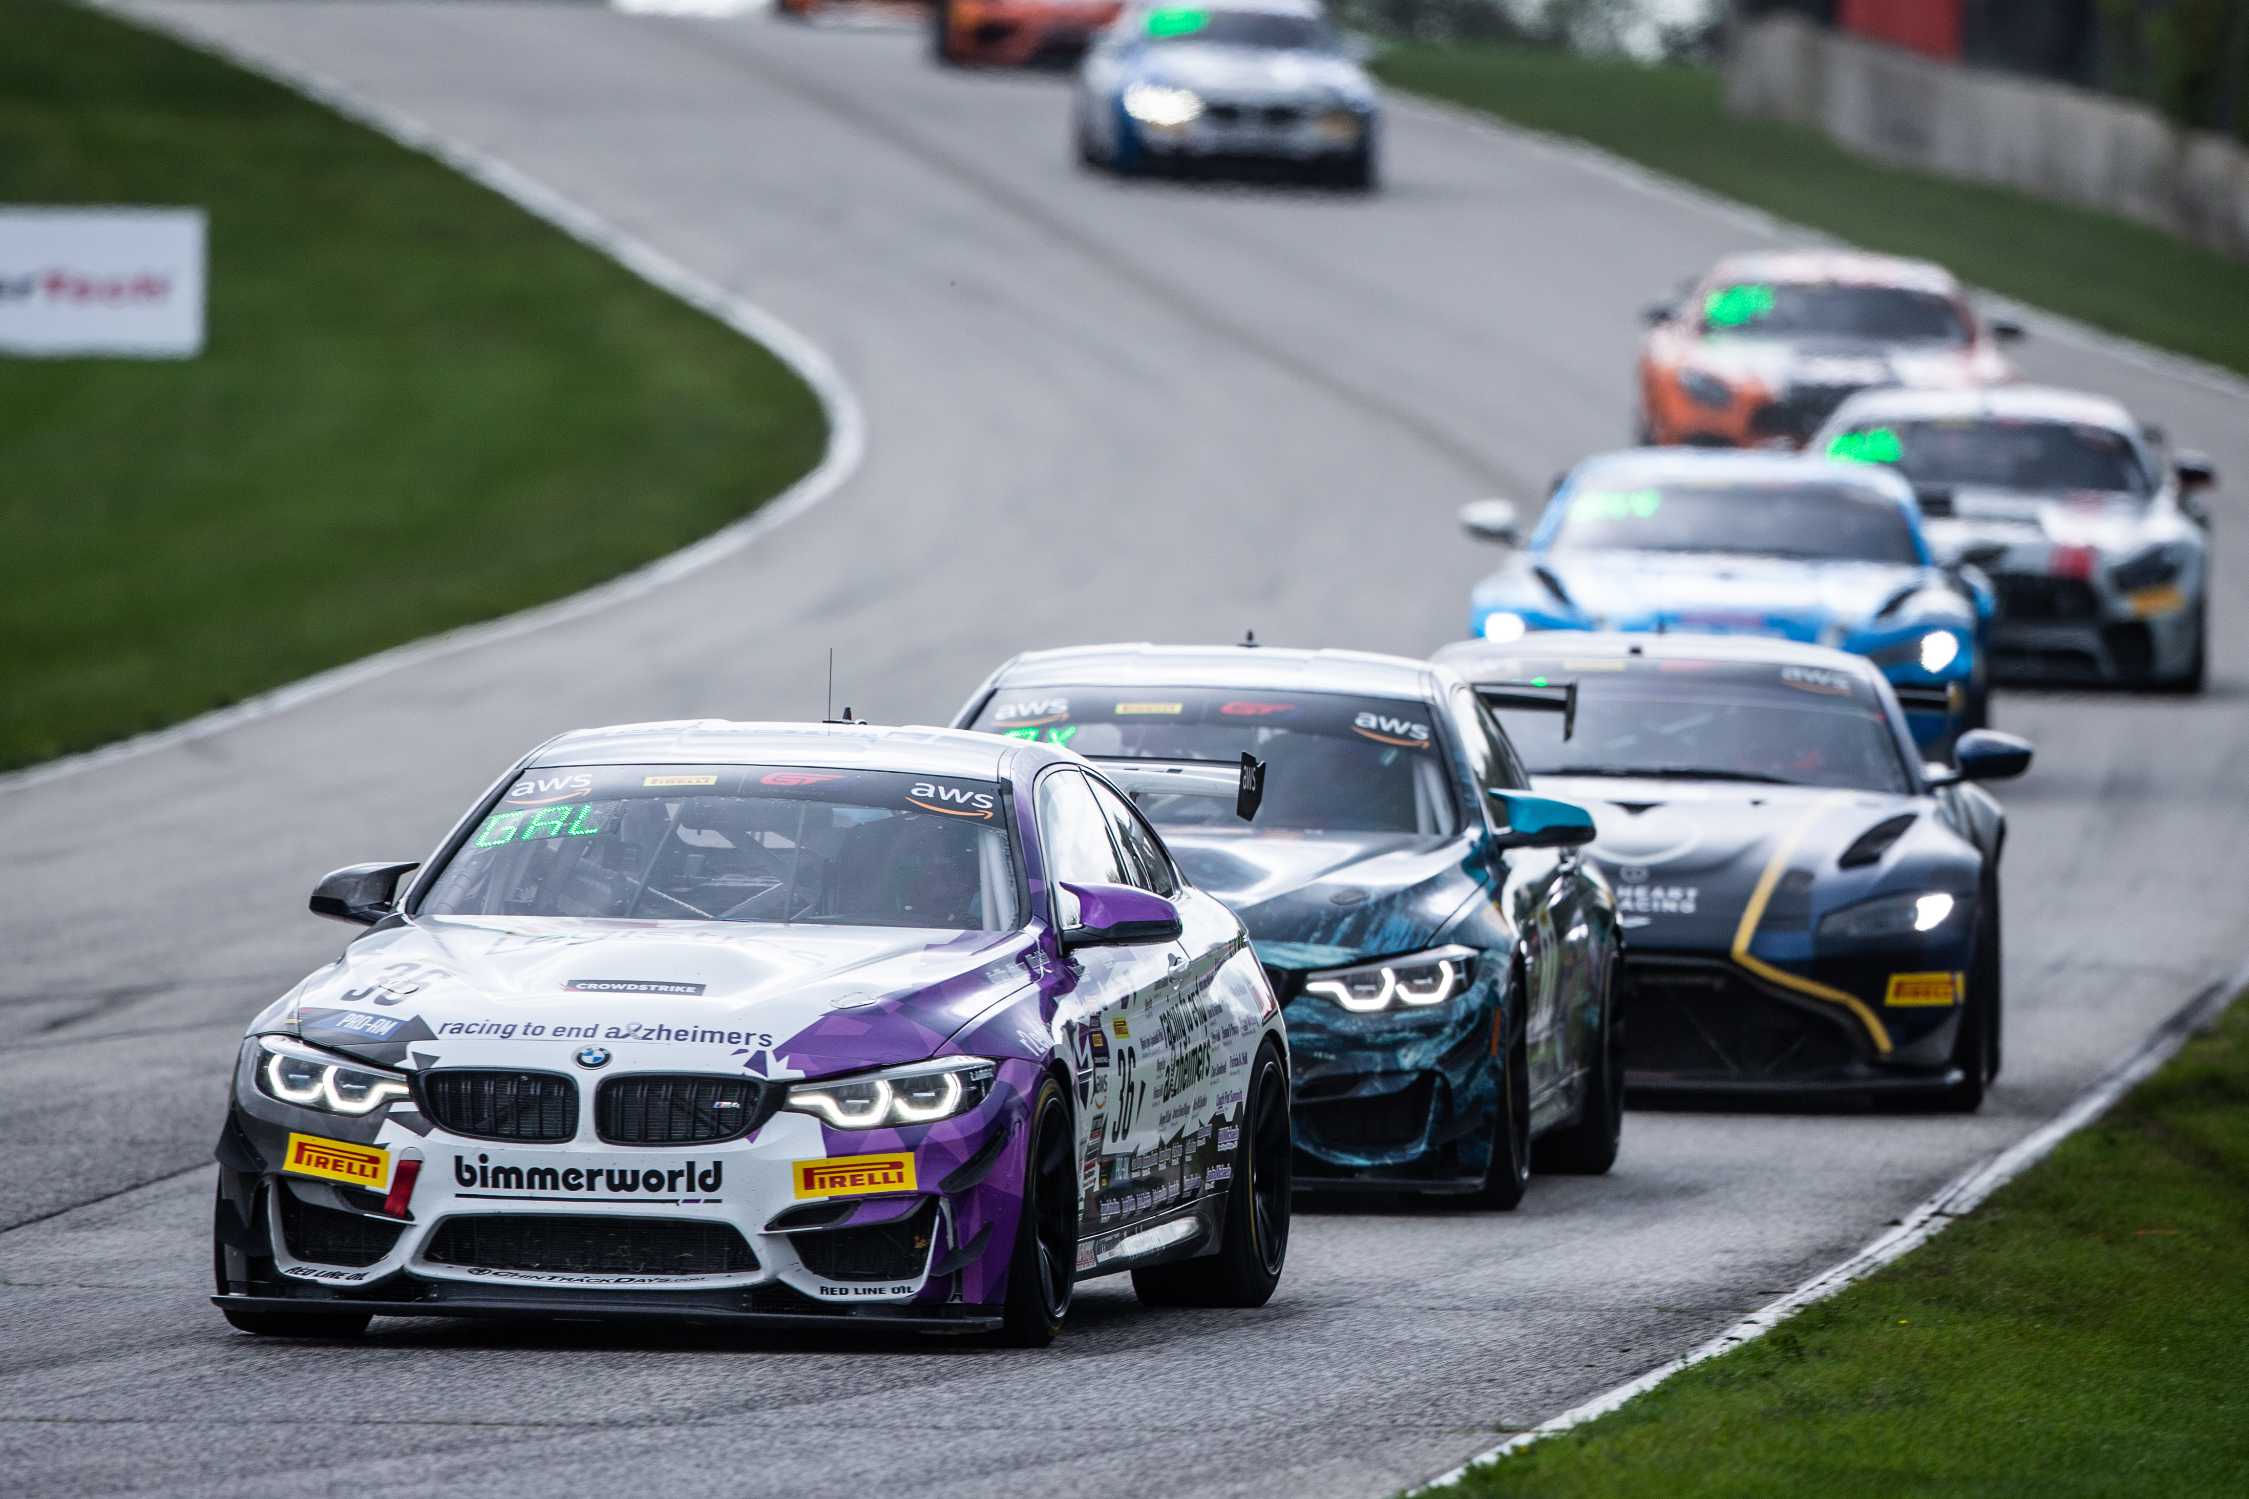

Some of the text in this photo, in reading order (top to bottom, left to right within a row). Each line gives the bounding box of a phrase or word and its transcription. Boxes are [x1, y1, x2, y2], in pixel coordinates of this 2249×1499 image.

[995, 699, 1068, 721] aws
[1355, 712, 1429, 740] aws
[511, 774, 592, 797] aws
[911, 782, 994, 809] aws
[475, 804, 598, 848] GAL
[1616, 886, 1697, 899] HEART
[1614, 900, 1696, 913] ACING
[576, 982, 697, 993] CROWDSTRIKE
[336, 1014, 399, 1036] PRO-AM
[438, 1019, 516, 1039] racing
[523, 1021, 545, 1037] to
[552, 1023, 599, 1038] end
[1111, 1046, 1136, 1143] 36
[293, 1141, 381, 1180] PIRELLI
[454, 1153, 723, 1193] bimmerworld
[803, 1161, 904, 1190] PIRELLI
[820, 1285, 914, 1296] RED LINE OIL
